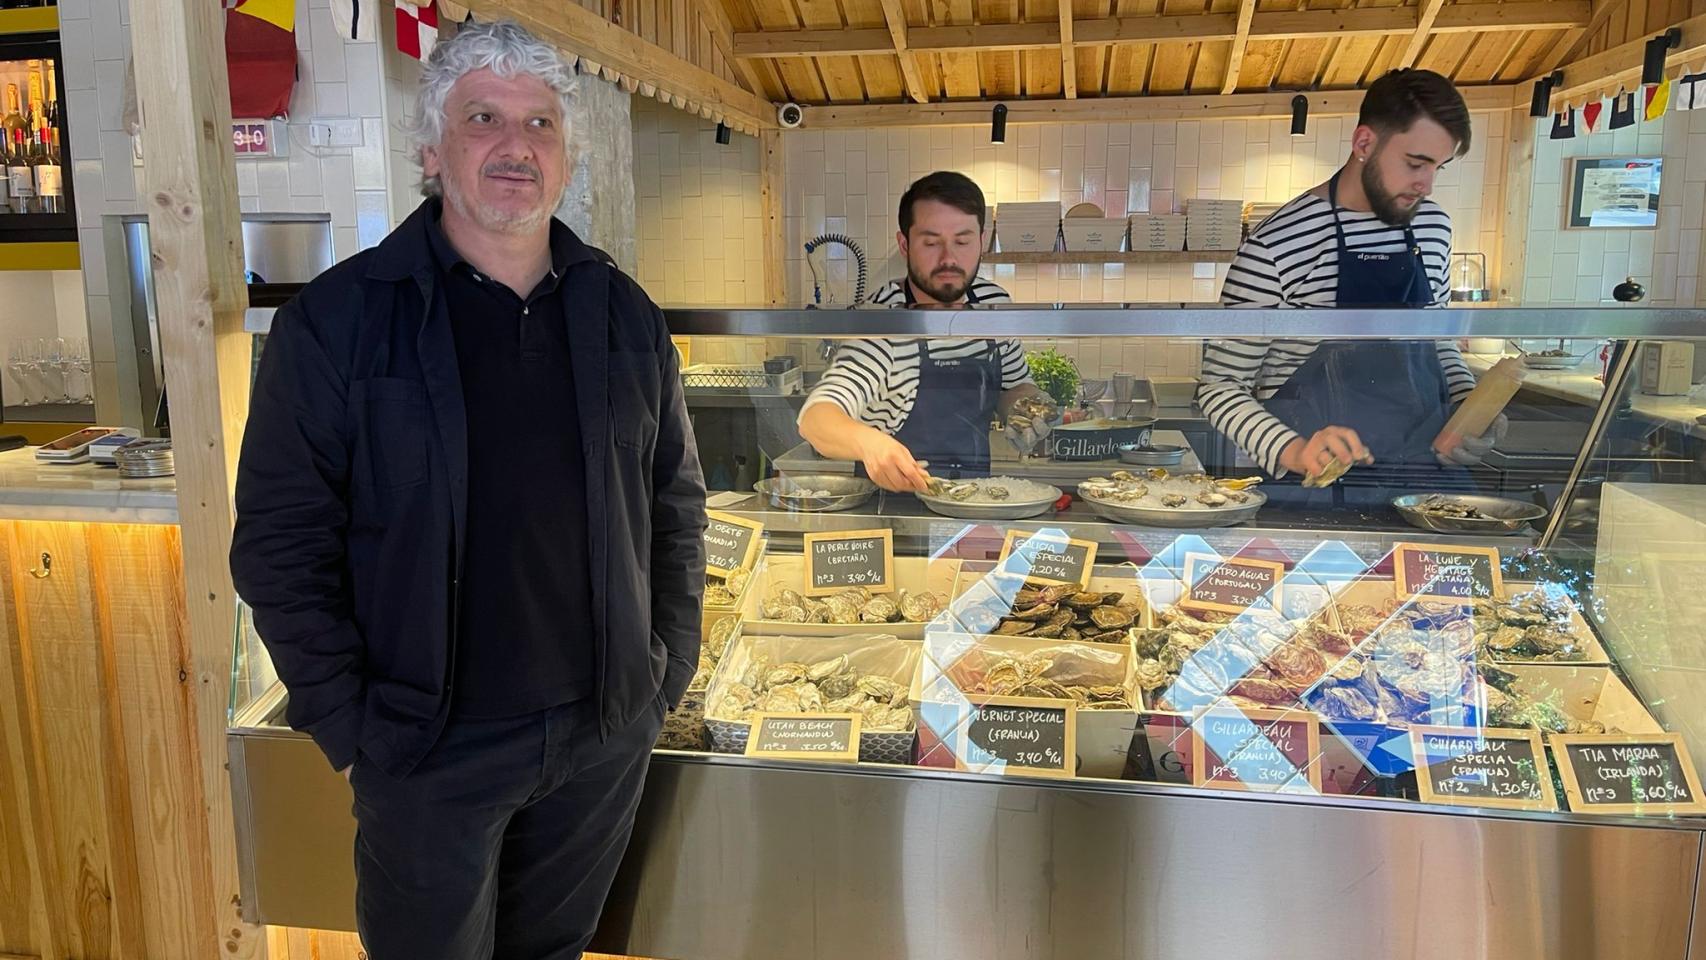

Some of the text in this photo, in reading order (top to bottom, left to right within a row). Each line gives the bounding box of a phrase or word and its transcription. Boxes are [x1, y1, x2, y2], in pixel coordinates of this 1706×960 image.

[816, 544, 826, 553] LA
[827, 542, 850, 552] PERLE
[1030, 551, 1076, 564] ESPECIAL
[1419, 553, 1430, 562] LA
[1436, 555, 1462, 565] LUNE
[1239, 569, 1270, 581] AGUAS
[1208, 578, 1262, 591] (PORTUGAL)
[1017, 710, 1064, 724] SPECIAL
[768, 721, 835, 731] UTAH BEACH
[1212, 720, 1292, 739] GILLARDEAU
[988, 727, 1040, 742] (FRANCIA)
[1234, 738, 1294, 752] SPECIAL
[1455, 754, 1519, 765] SPECIAL
[1579, 746, 1660, 762] TIA MARAA
[1598, 764, 1663, 781] (IRLANDA)
